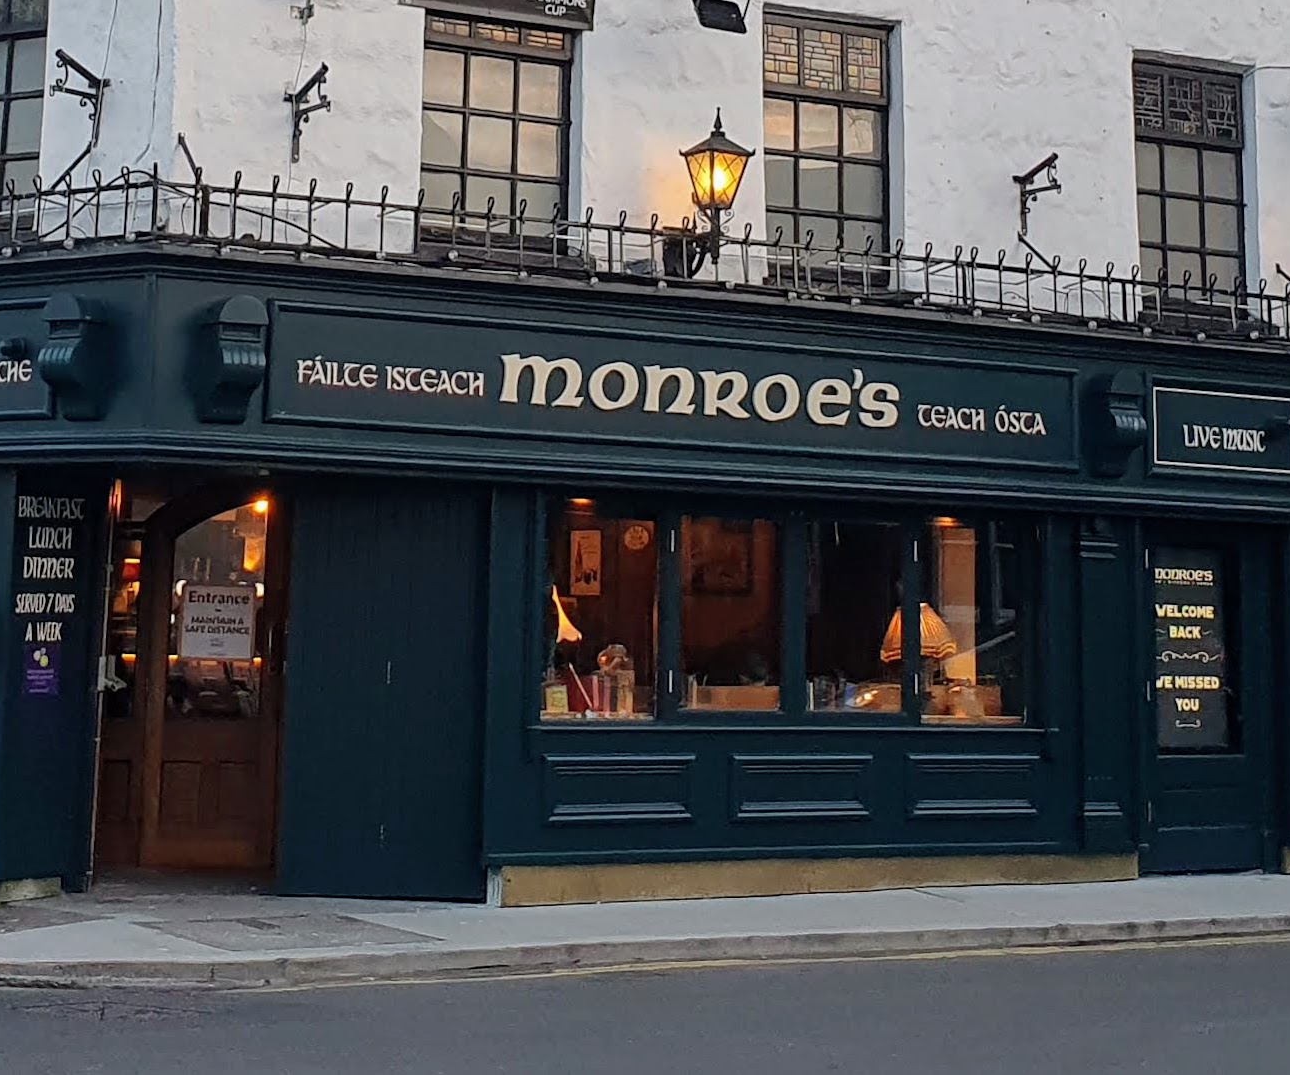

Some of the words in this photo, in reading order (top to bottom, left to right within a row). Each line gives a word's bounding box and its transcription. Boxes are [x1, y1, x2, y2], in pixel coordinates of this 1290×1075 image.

[545, 4, 567, 17] CUP
[297, 355, 378, 388] FÁILTE
[385, 365, 484, 397] ISTEACH
[917, 404, 986, 431] TEACH
[994, 404, 1047, 436] ÓSTA
[1183, 424, 1221, 449] LIVE
[1222, 427, 1266, 452] MUSIC
[18, 495, 85, 521] BREAKFAST
[28, 526, 73, 550] LUNCH
[23, 556, 75, 579] DINNER
[15, 593, 46, 614] SERVED
[46, 593, 54, 613] 7
[54, 593, 76, 614] DAYS
[188, 590, 250, 604] Entrance
[1155, 603, 1214, 619] WELCOME
[191, 616, 236, 625] MAINTAIN
[237, 617, 244, 625] A
[25, 622, 33, 642] A
[36, 621, 62, 642] WEEK
[184, 625, 206, 634] SAFE
[207, 626, 250, 635] DISTANCE
[1169, 625, 1201, 639] BACK
[1174, 676, 1219, 689] MISSED
[1175, 697, 1200, 711] YOU
